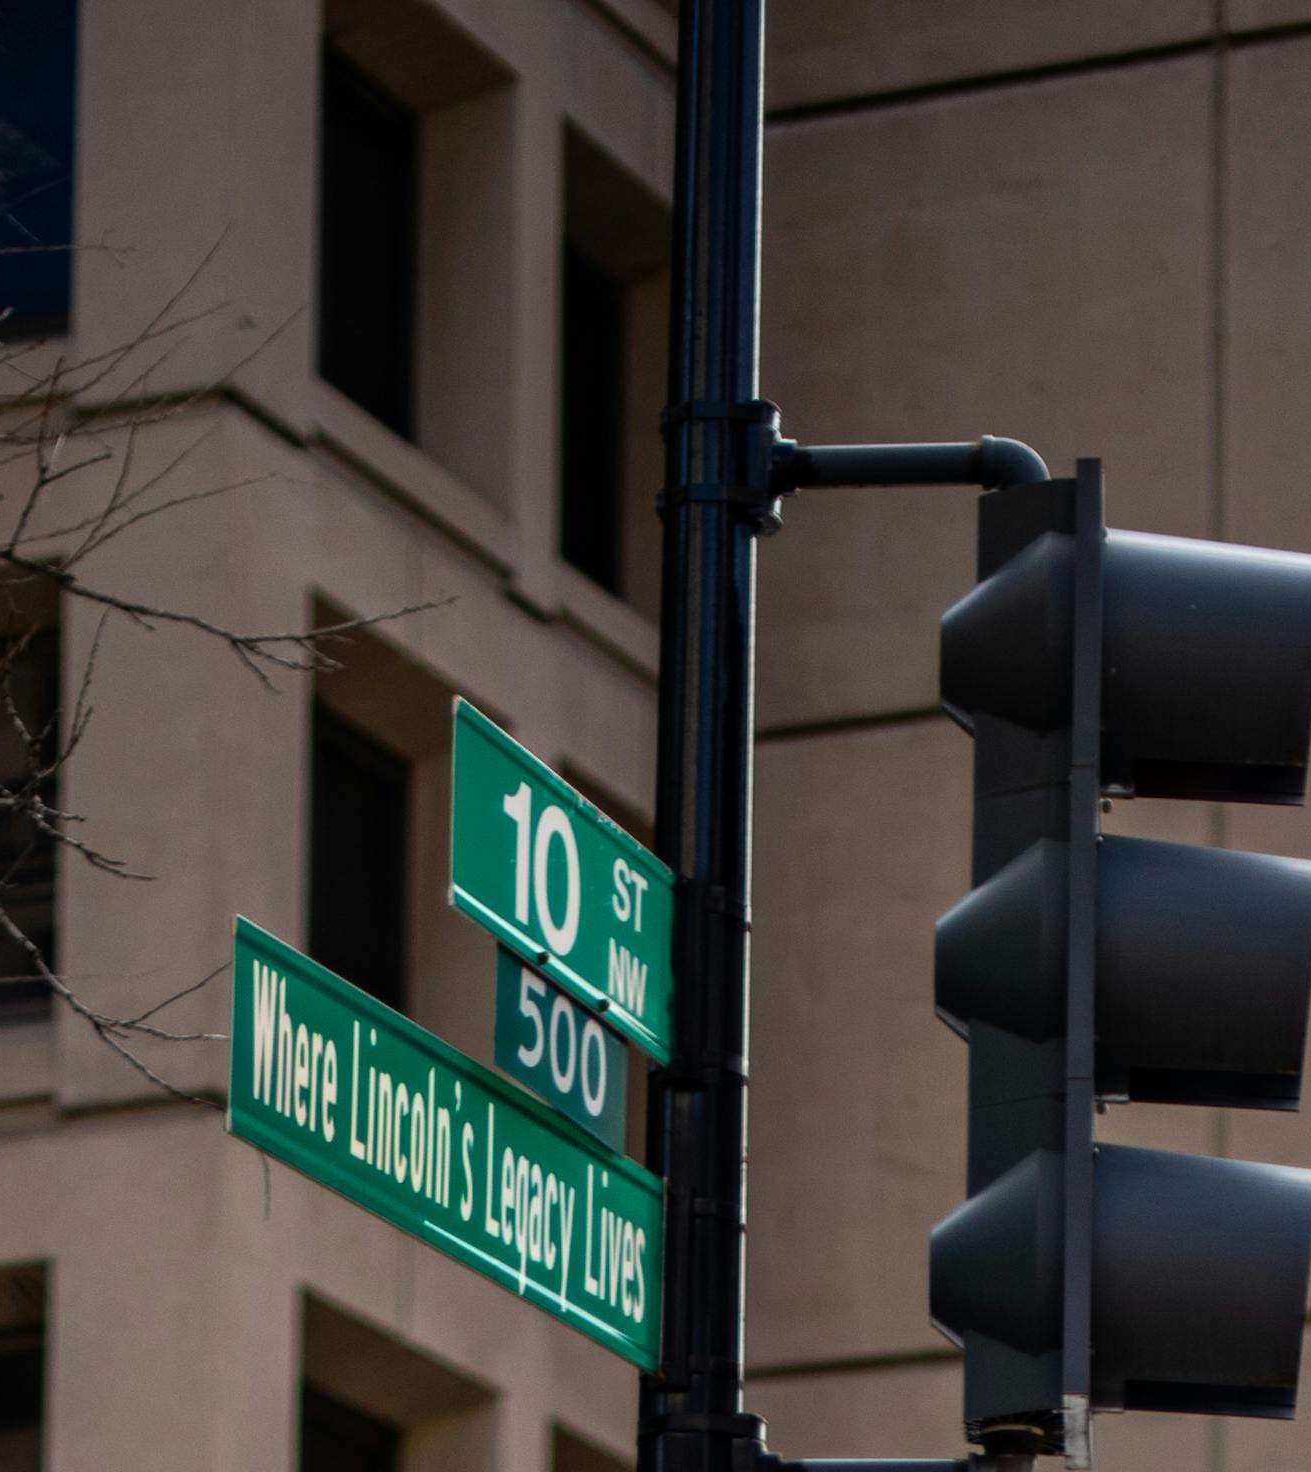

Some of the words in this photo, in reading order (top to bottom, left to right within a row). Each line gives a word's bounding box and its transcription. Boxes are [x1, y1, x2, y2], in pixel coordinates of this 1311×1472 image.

[503, 781, 581, 957] 10
[612, 857, 648, 933] ST
[516, 969, 608, 1117] 500
[608, 937, 648, 1018] NW
[252, 959, 339, 1143] Where
[349, 1019, 475, 1222] Lincoln's
[486, 1102, 575, 1312] Legacy
[585, 1163, 646, 1324] Lives
